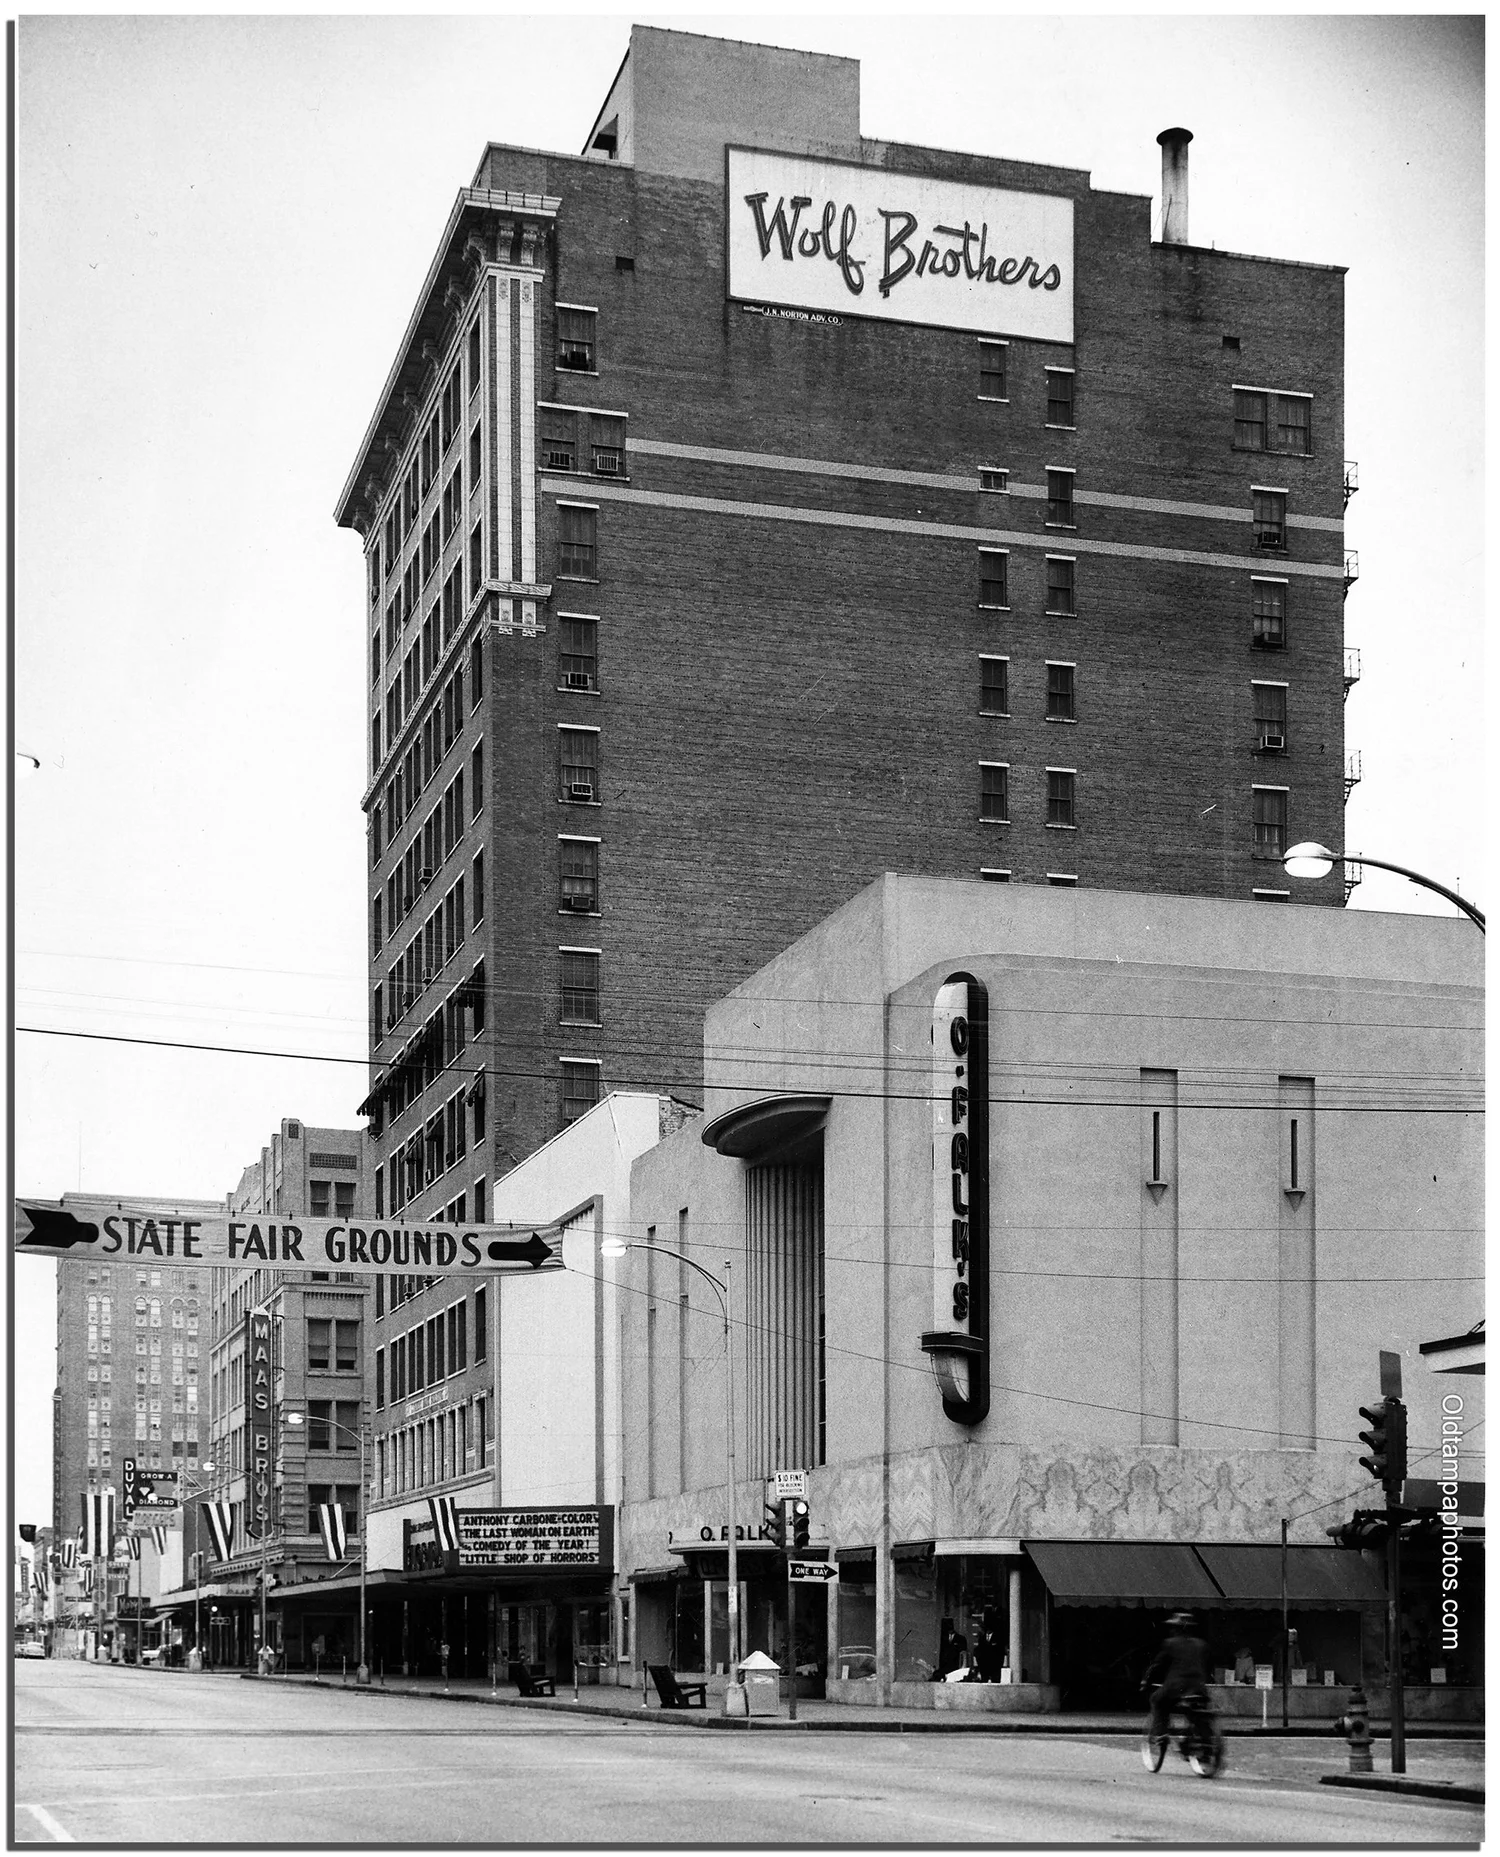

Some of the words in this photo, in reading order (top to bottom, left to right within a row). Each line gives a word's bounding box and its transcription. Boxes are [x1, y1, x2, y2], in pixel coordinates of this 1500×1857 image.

[744, 192, 866, 295] Wolf
[878, 207, 1061, 298] Brothers
[780, 309, 808, 320] NORTON
[102, 1215, 202, 1258] STATE
[228, 1222, 305, 1262] FAIR
[325, 1226, 481, 1267] GROUNDS
[255, 1322, 268, 1409] MAAS
[141, 1472, 164, 1480] GROW
[167, 1472, 173, 1480] A
[125, 1461, 134, 1517] DUVAL
[464, 1515, 510, 1526] ANTHONY
[483, 1527, 508, 1539] LAST
[510, 1527, 548, 1538] WOMAN
[548, 1526, 562, 1537] ON
[473, 1540, 511, 1551] COMEDY
[515, 1540, 529, 1551] OF
[532, 1540, 551, 1550] THE
[504, 1553, 529, 1564] SHOP
[533, 1553, 546, 1563] OF
[795, 1567, 810, 1576] ONE
[813, 1568, 829, 1577] WAY
